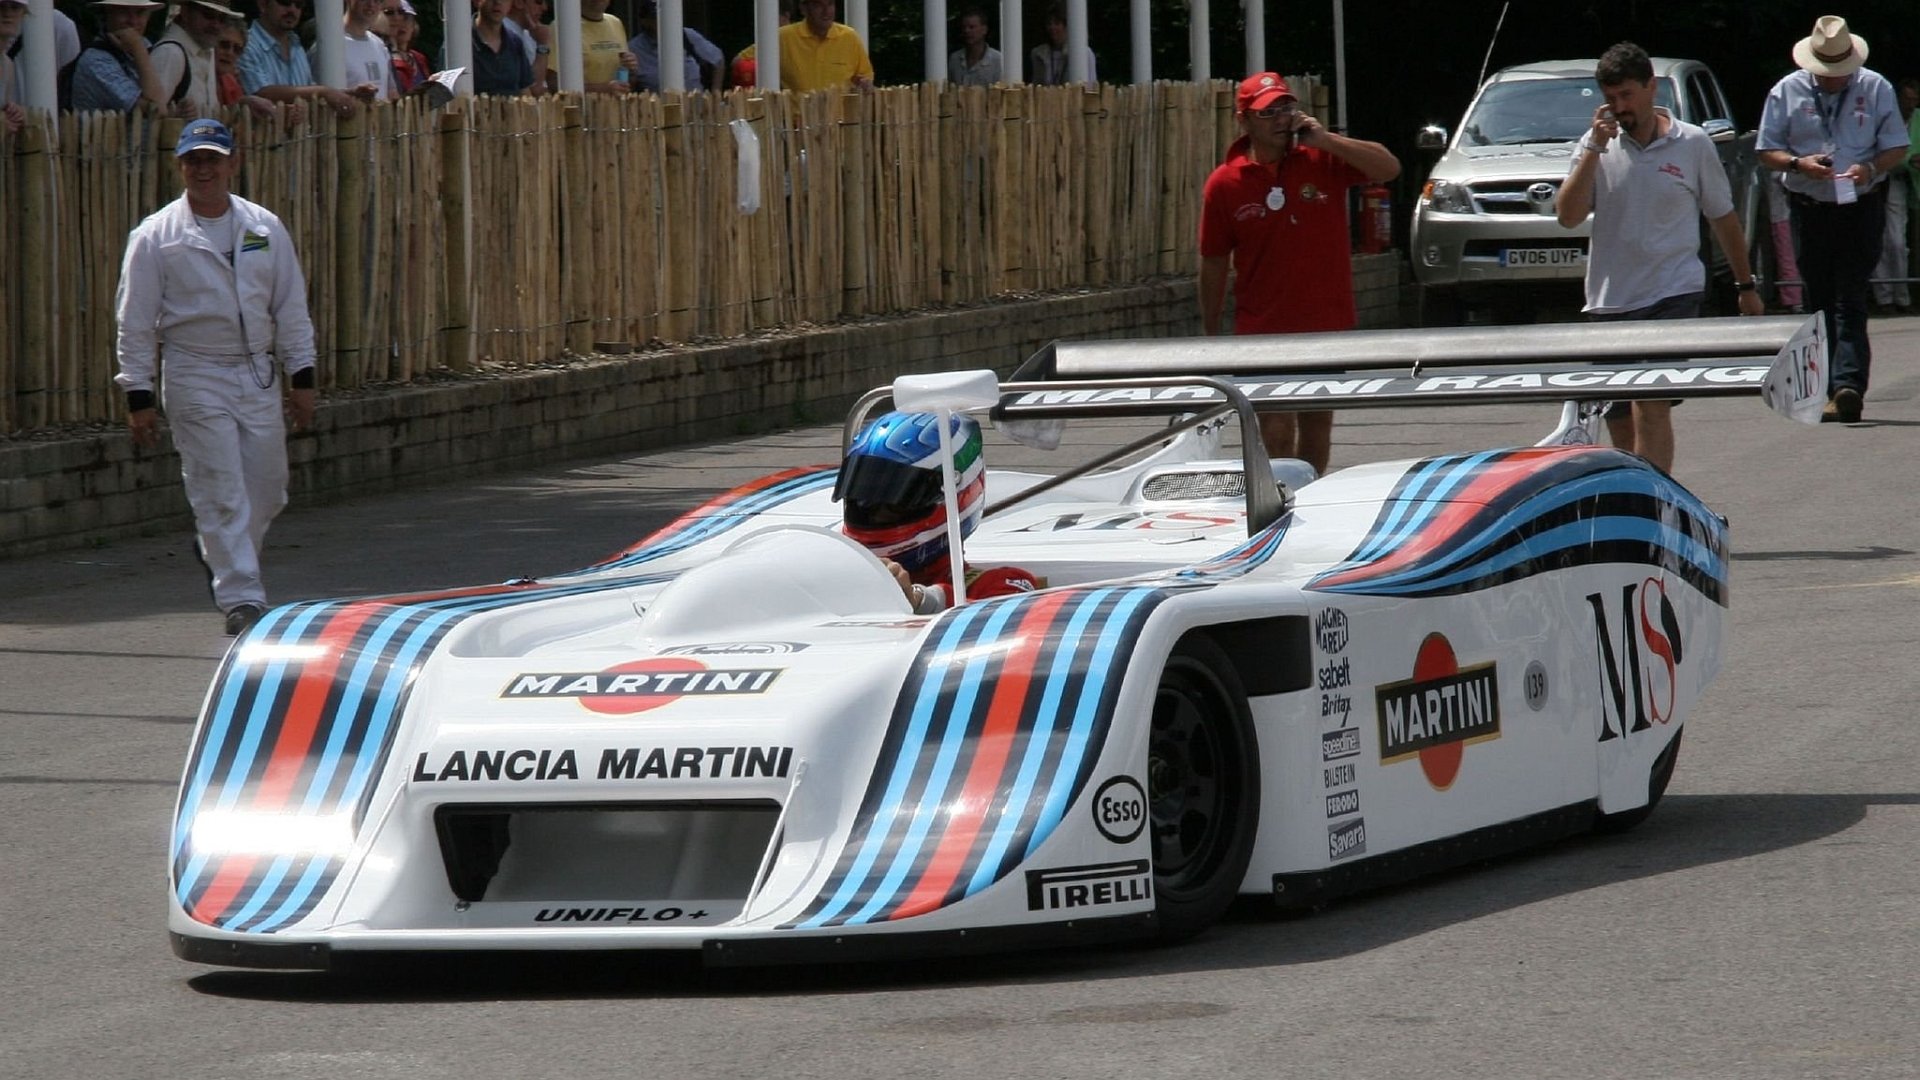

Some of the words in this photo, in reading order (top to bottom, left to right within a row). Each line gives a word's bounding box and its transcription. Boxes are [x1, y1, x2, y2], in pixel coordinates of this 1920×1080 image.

[1551, 249, 1578, 264] UYF
[1415, 365, 1770, 391] RACING
[1319, 656, 1350, 690] sabelt
[1586, 577, 1682, 742] MS
[511, 671, 775, 695] MARTINI
[1527, 673, 1544, 700] 139
[1322, 693, 1351, 728] Britax
[1385, 676, 1493, 747] MARTINI
[413, 749, 578, 782] LANCIA
[597, 746, 793, 780] MARTINI
[1324, 763, 1355, 788] BILSTEIN
[1328, 792, 1357, 815] FERODO
[1330, 826, 1364, 857] Savara
[1025, 858, 1150, 911] PIRELLI
